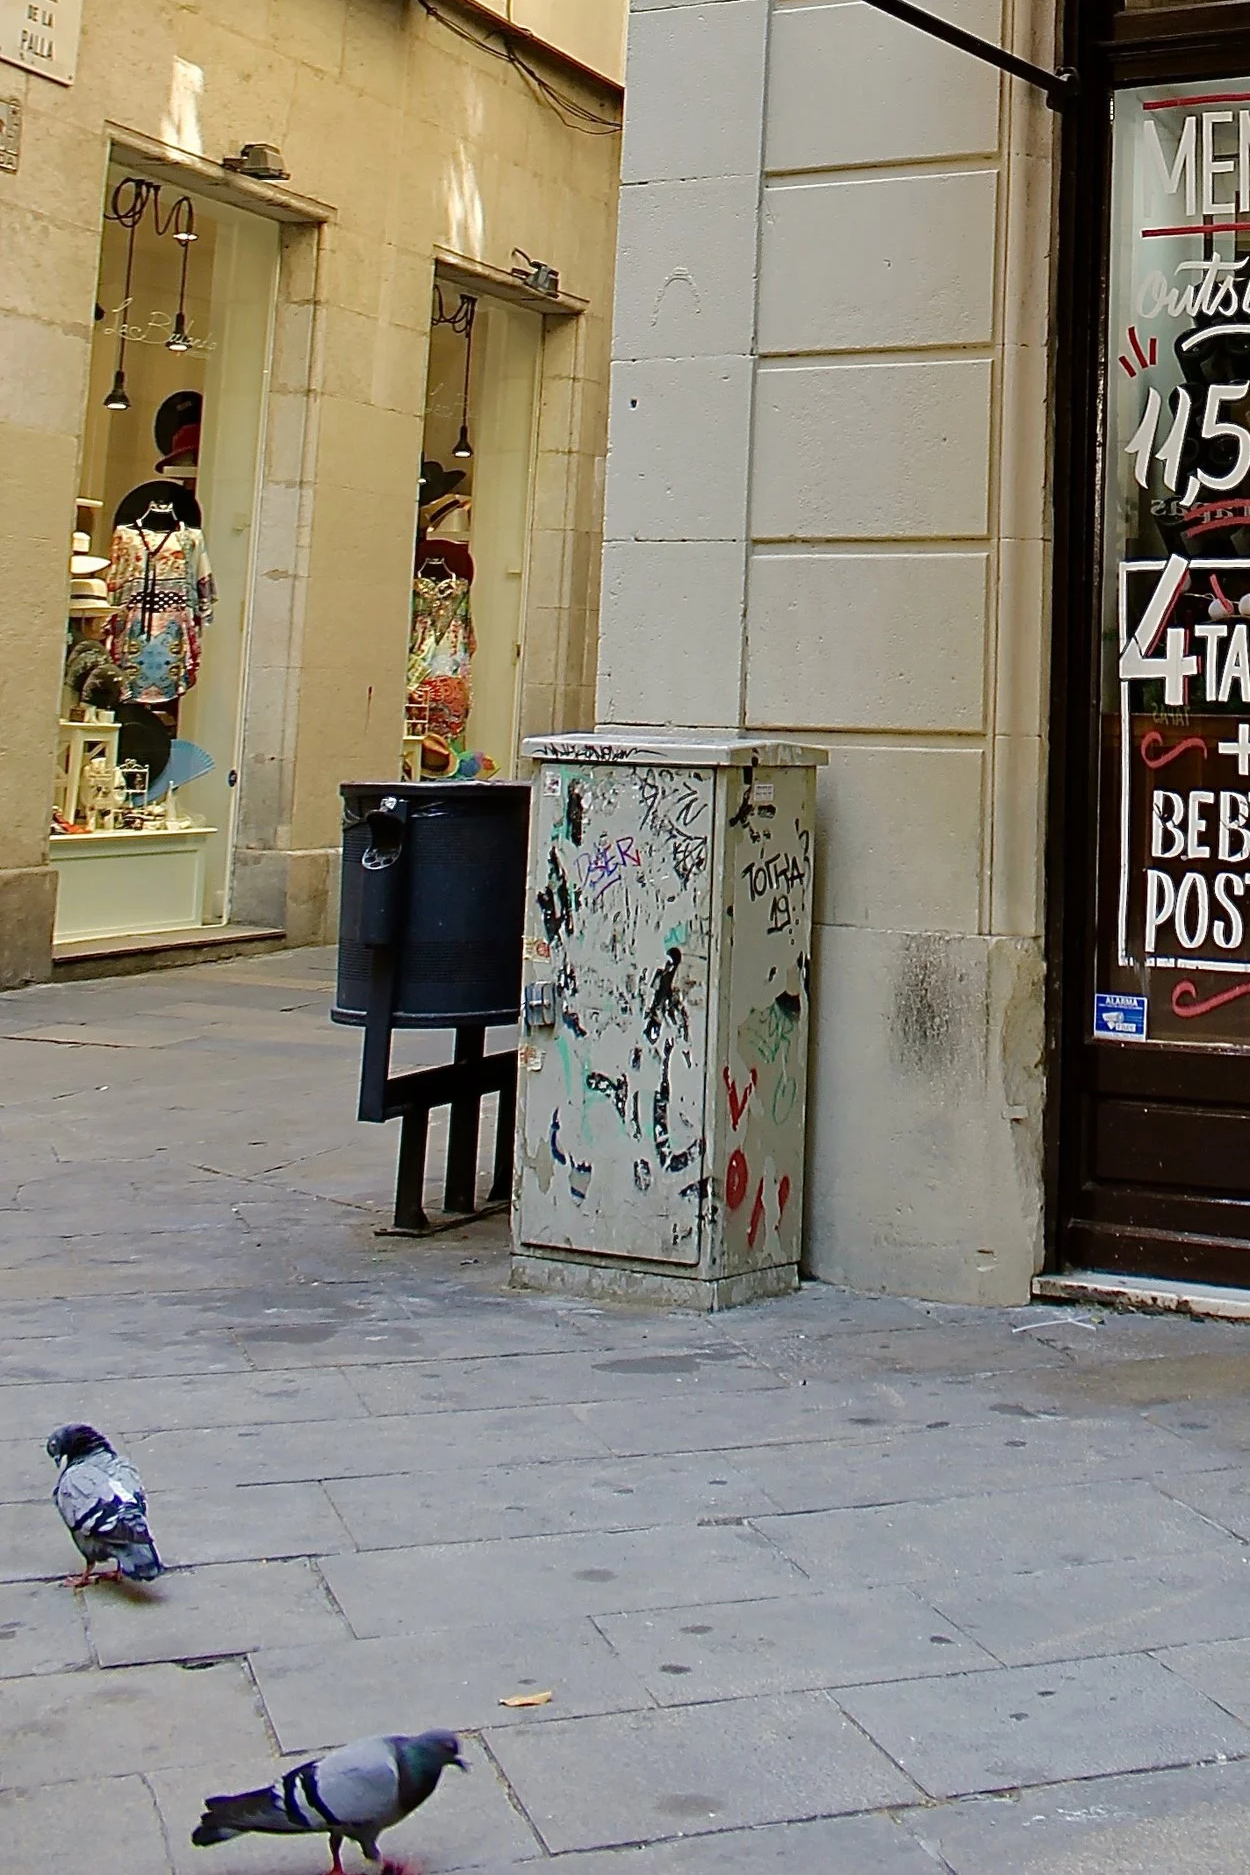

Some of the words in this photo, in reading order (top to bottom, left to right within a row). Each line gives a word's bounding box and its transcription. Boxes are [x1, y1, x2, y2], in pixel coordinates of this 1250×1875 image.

[27, 4, 39, 22] DE
[42, 10, 54, 28] LA
[1119, 553, 1199, 705] 4
